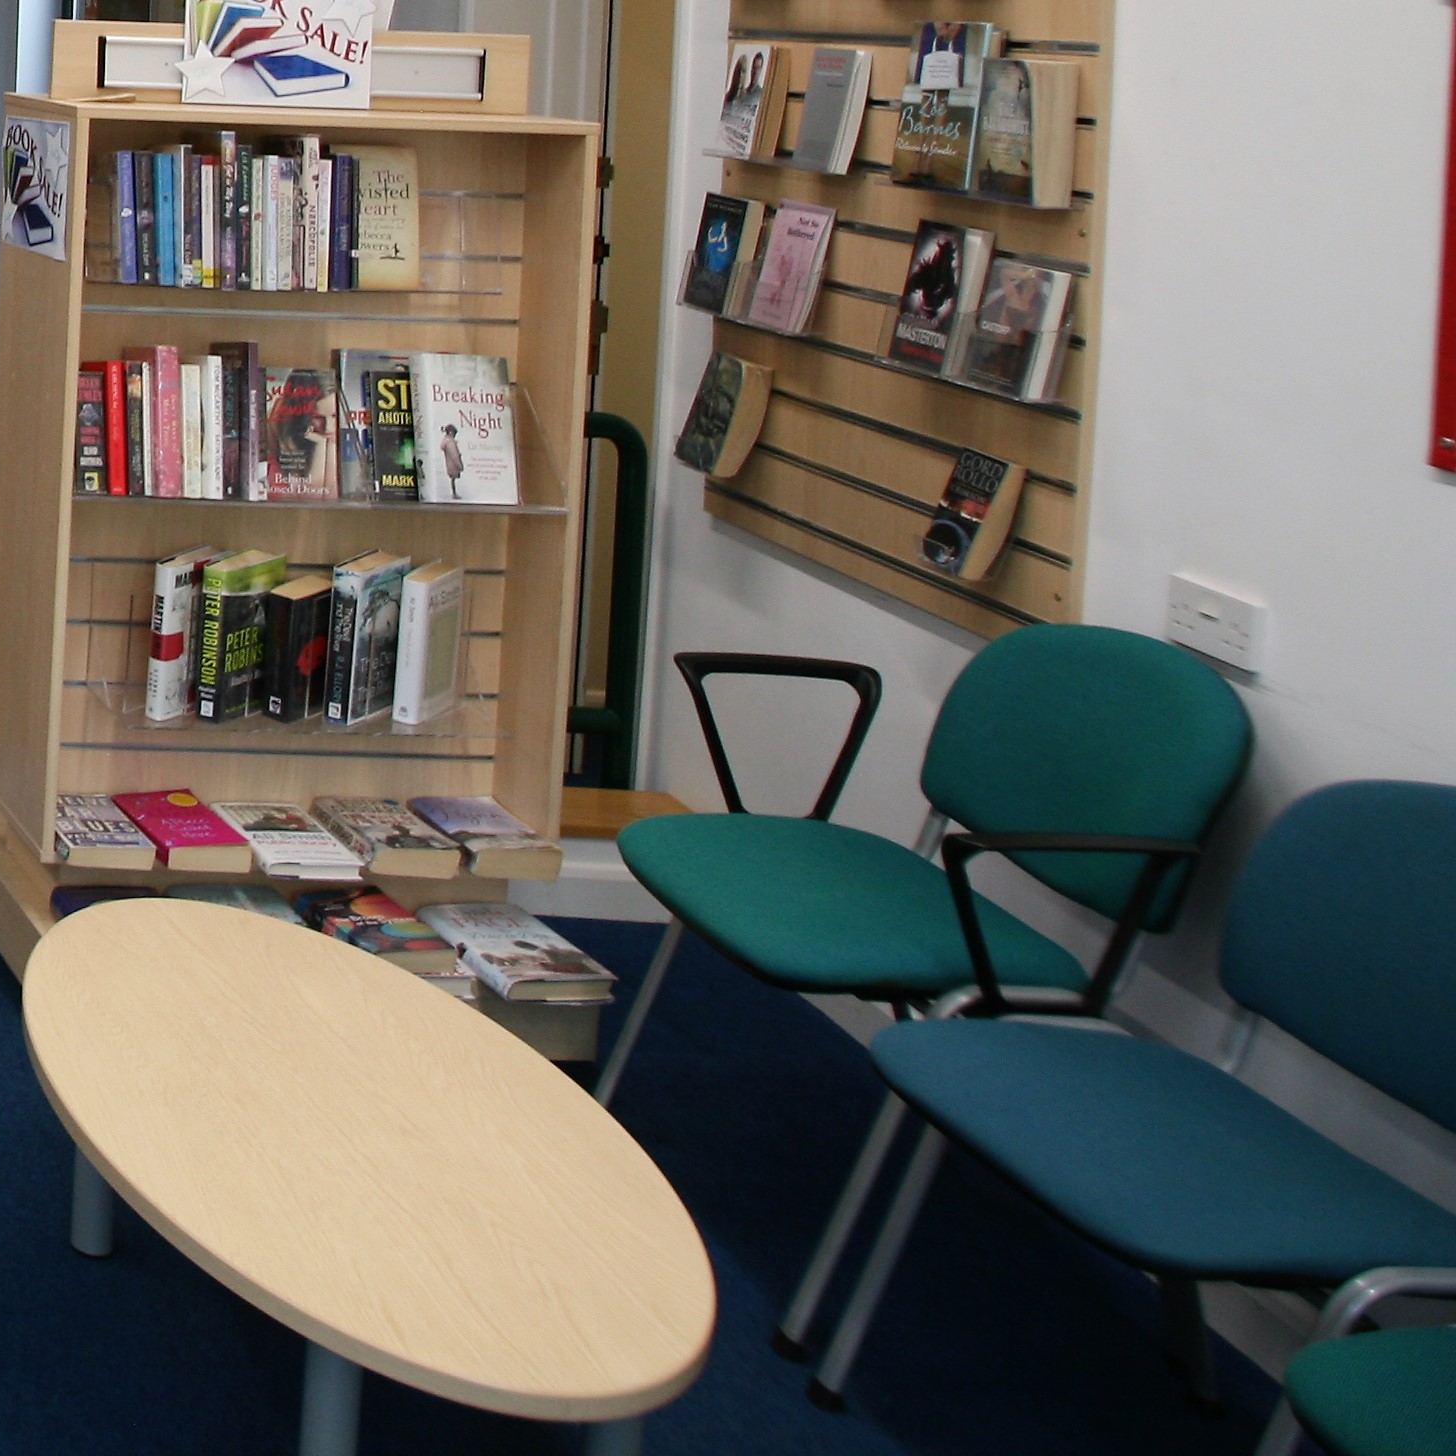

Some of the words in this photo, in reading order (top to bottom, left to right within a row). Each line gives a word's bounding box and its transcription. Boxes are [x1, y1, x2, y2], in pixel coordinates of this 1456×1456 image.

[296, 6, 369, 65] SALE!
[899, 106, 961, 140] Barnes
[6, 124, 37, 164] BOOK
[38, 156, 63, 218] SALE!
[372, 169, 404, 183] The
[363, 203, 398, 216] eart
[377, 379, 411, 411] ST
[432, 384, 505, 412] Breaking
[378, 411, 412, 426] ANOTH
[459, 409, 503, 439] Night
[275, 473, 312, 484] Behind
[297, 484, 330, 496] Doors
[382, 474, 416, 487] MARK
[205, 578, 222, 616] PETER
[201, 620, 220, 685] ROBINSON
[227, 626, 259, 653] PETER
[225, 643, 264, 672] ROBINS
